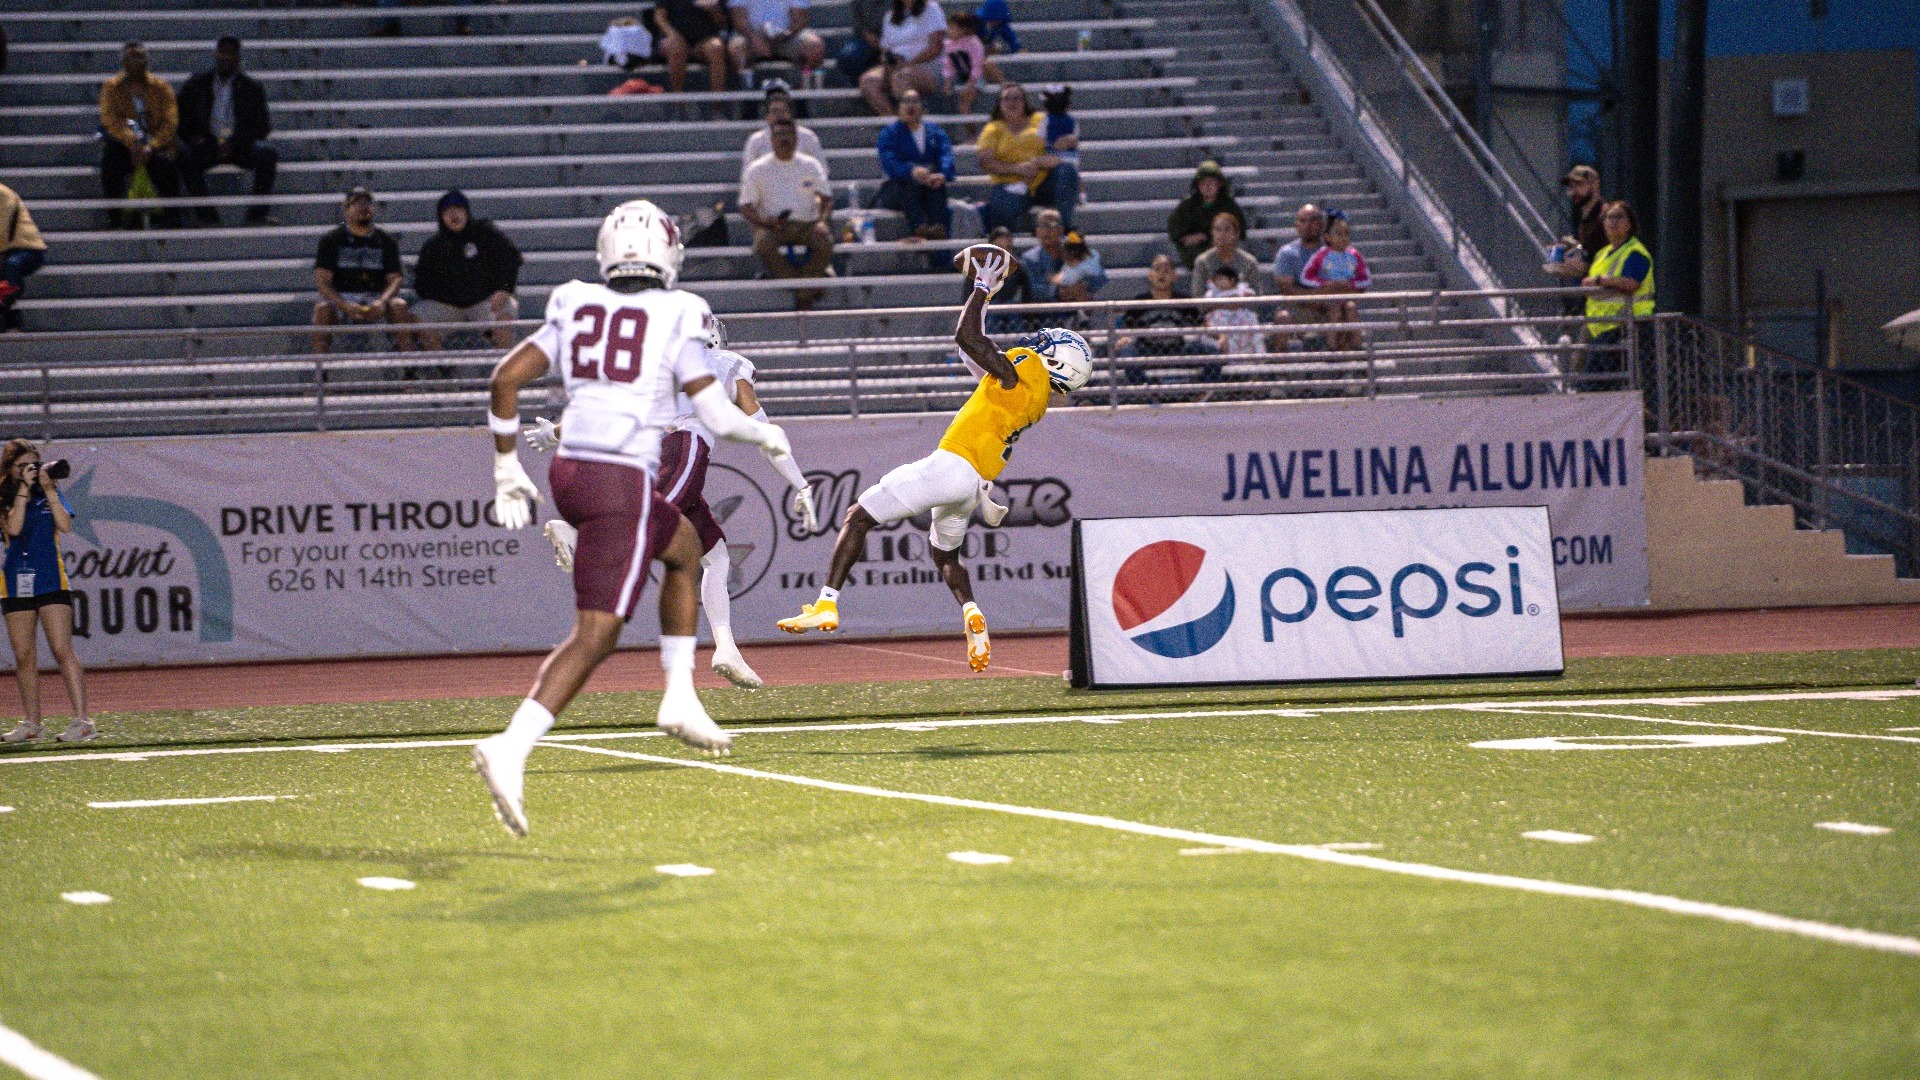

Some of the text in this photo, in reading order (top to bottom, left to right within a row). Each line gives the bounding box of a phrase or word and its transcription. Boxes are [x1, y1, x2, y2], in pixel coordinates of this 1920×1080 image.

[571, 303, 648, 383] 28
[1222, 438, 1627, 501] JAVELINA ALUMNI
[221, 504, 334, 536] DRIVE
[65, 542, 175, 579] count
[242, 534, 519, 567] For your convenience
[858, 531, 1010, 563] LIQOR
[1552, 534, 1613, 565] COM
[268, 564, 496, 592] 626 N 14th Street
[978, 562, 1034, 581] Blvd
[1042, 560, 1072, 579] Su
[1260, 545, 1524, 642] pepsi
[72, 585, 193, 639] QUOR
